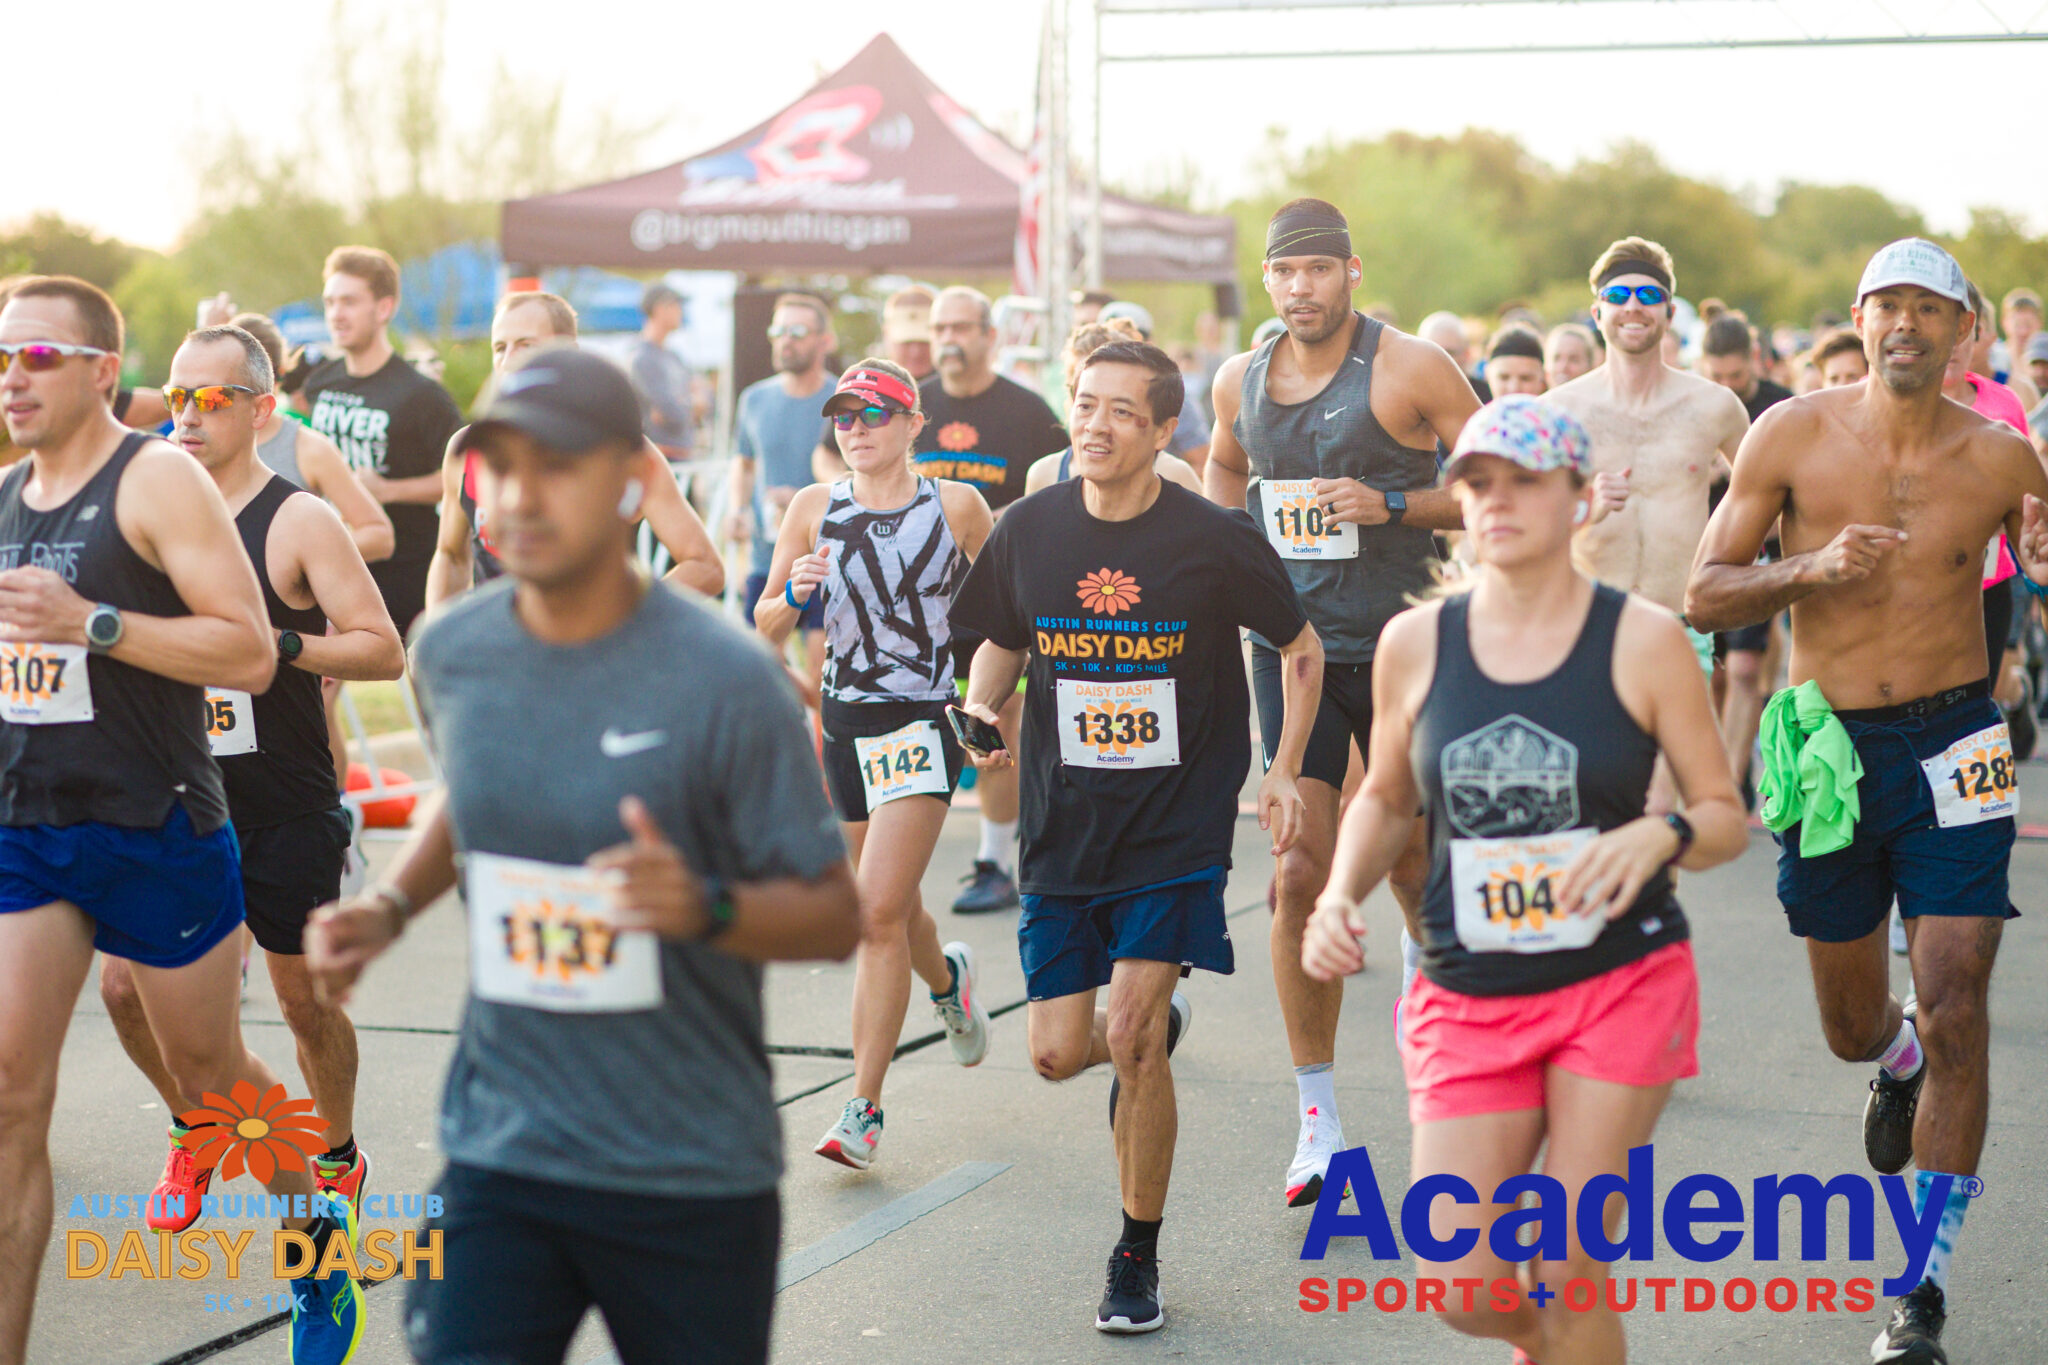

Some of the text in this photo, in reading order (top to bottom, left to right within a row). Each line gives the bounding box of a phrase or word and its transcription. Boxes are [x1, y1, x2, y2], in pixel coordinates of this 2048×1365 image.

[311, 401, 390, 441] RIVER
[1273, 483, 1304, 493] DAISY
[1274, 507, 1342, 536] 1102
[1292, 547, 1322, 555] Academy
[1036, 616, 1187, 632] AUSTIN RUNNERS CLUB
[1037, 631, 1184, 660] DAISY DASH
[0, 656, 67, 693] 107
[1055, 662, 1168, 673] 5K 10K KID'S MILE
[1076, 684, 1152, 697] DAISY DASH
[1074, 711, 1160, 744] 1338
[1944, 735, 1978, 762] DAISY
[1982, 727, 2008, 742] DAS
[863, 746, 932, 786] 1142
[1097, 755, 1135, 764] Academy
[1476, 877, 1555, 919] 104
